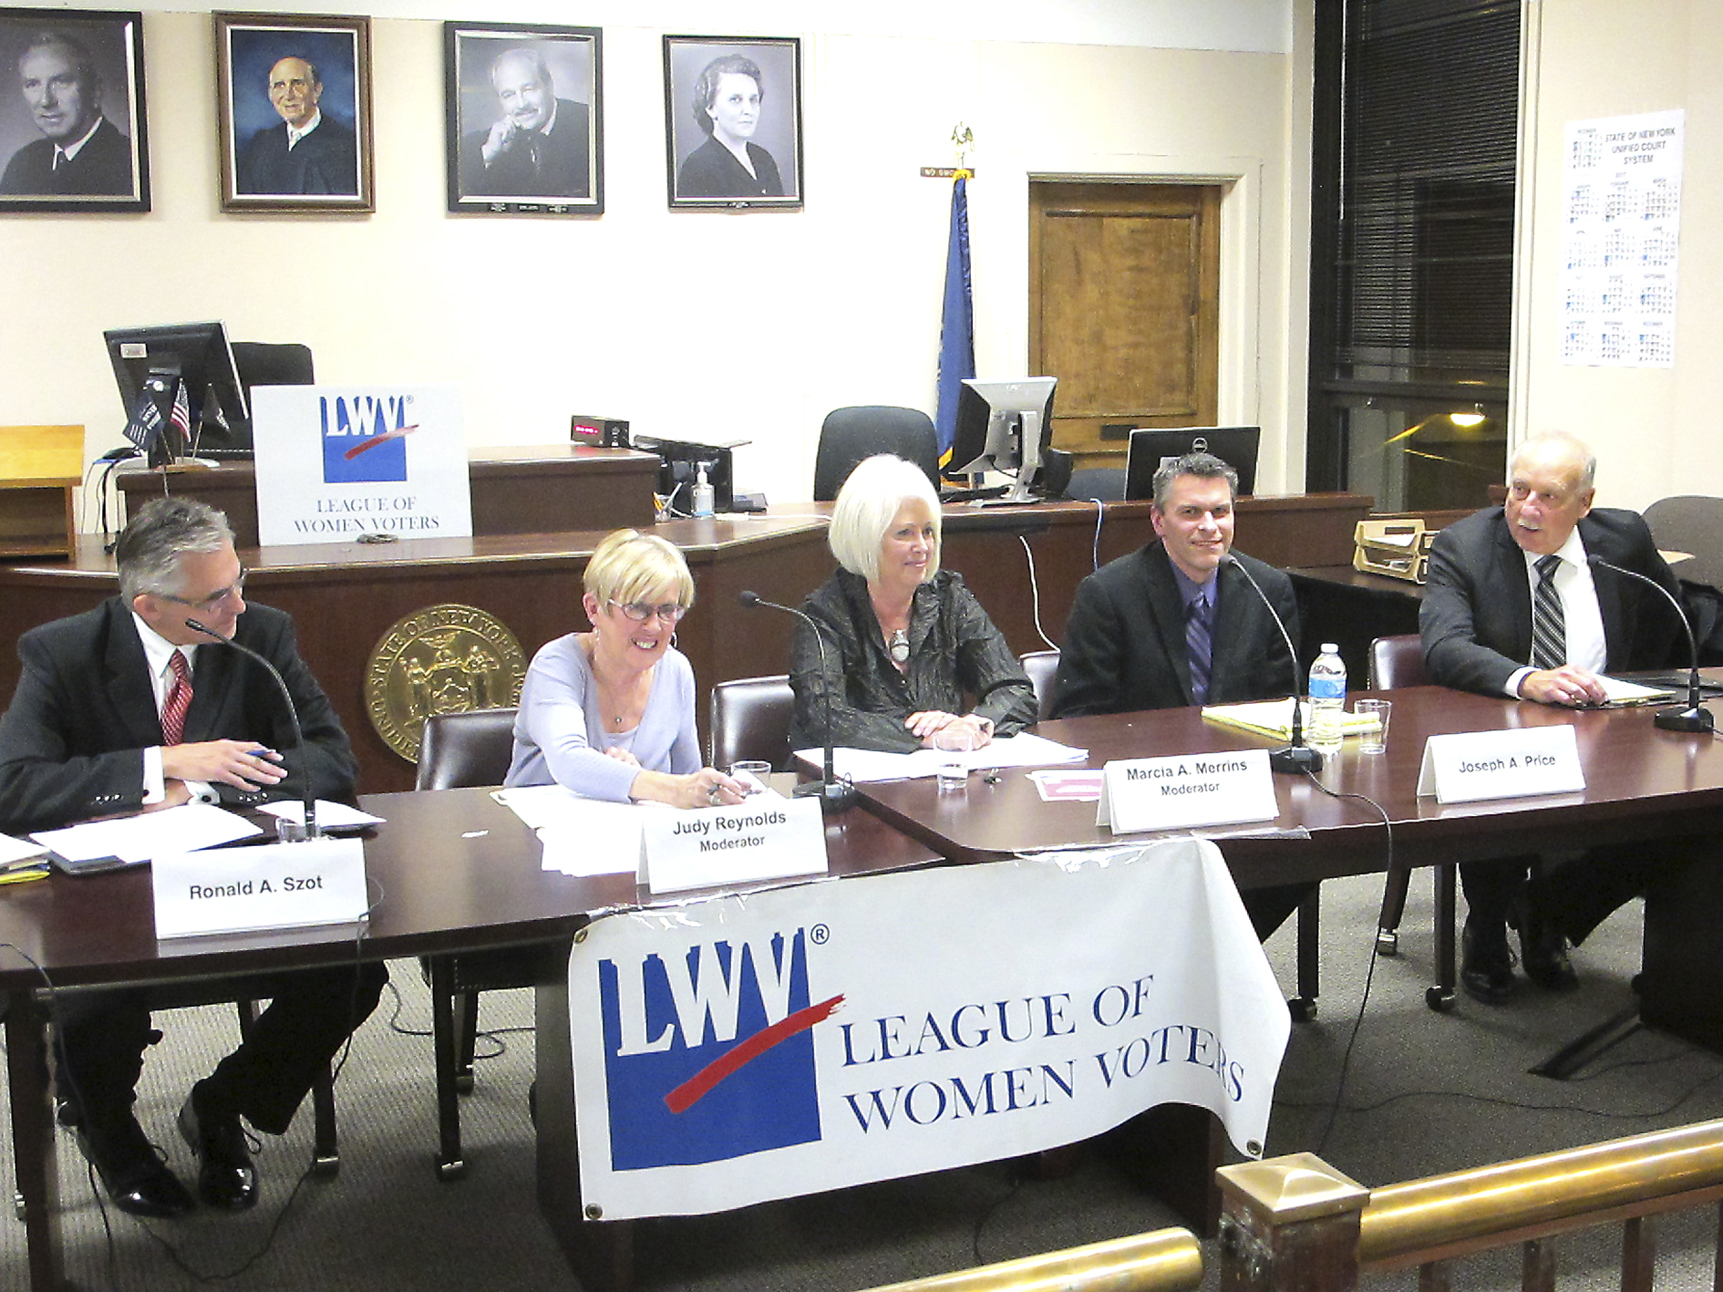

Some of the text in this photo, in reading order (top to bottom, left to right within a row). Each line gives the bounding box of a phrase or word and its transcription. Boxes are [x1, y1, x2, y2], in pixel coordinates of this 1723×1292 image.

[1605, 127, 1676, 142] STATE OF NEW YORK
[1612, 140, 1666, 153] UNIFIED COURT
[1624, 154, 1654, 165] SYSTEM
[325, 395, 403, 437] LWV
[317, 496, 417, 513] LEAGUE OF
[294, 515, 440, 533] WOMEN VOTERS
[431, 609, 477, 625] NEW
[1126, 759, 1248, 781] Marcia A. Merrins
[1458, 754, 1556, 774] Joseph A. Price
[1160, 782, 1220, 796] Moderator
[673, 811, 787, 836] Judy Reynolds
[699, 836, 766, 853] Moderator
[189, 875, 323, 900] Ronald A. Szot
[612, 928, 806, 1057] LWV
[840, 974, 1155, 1067] LEAGUE OF
[842, 1025, 1244, 1134] WOMEN VOTERS
